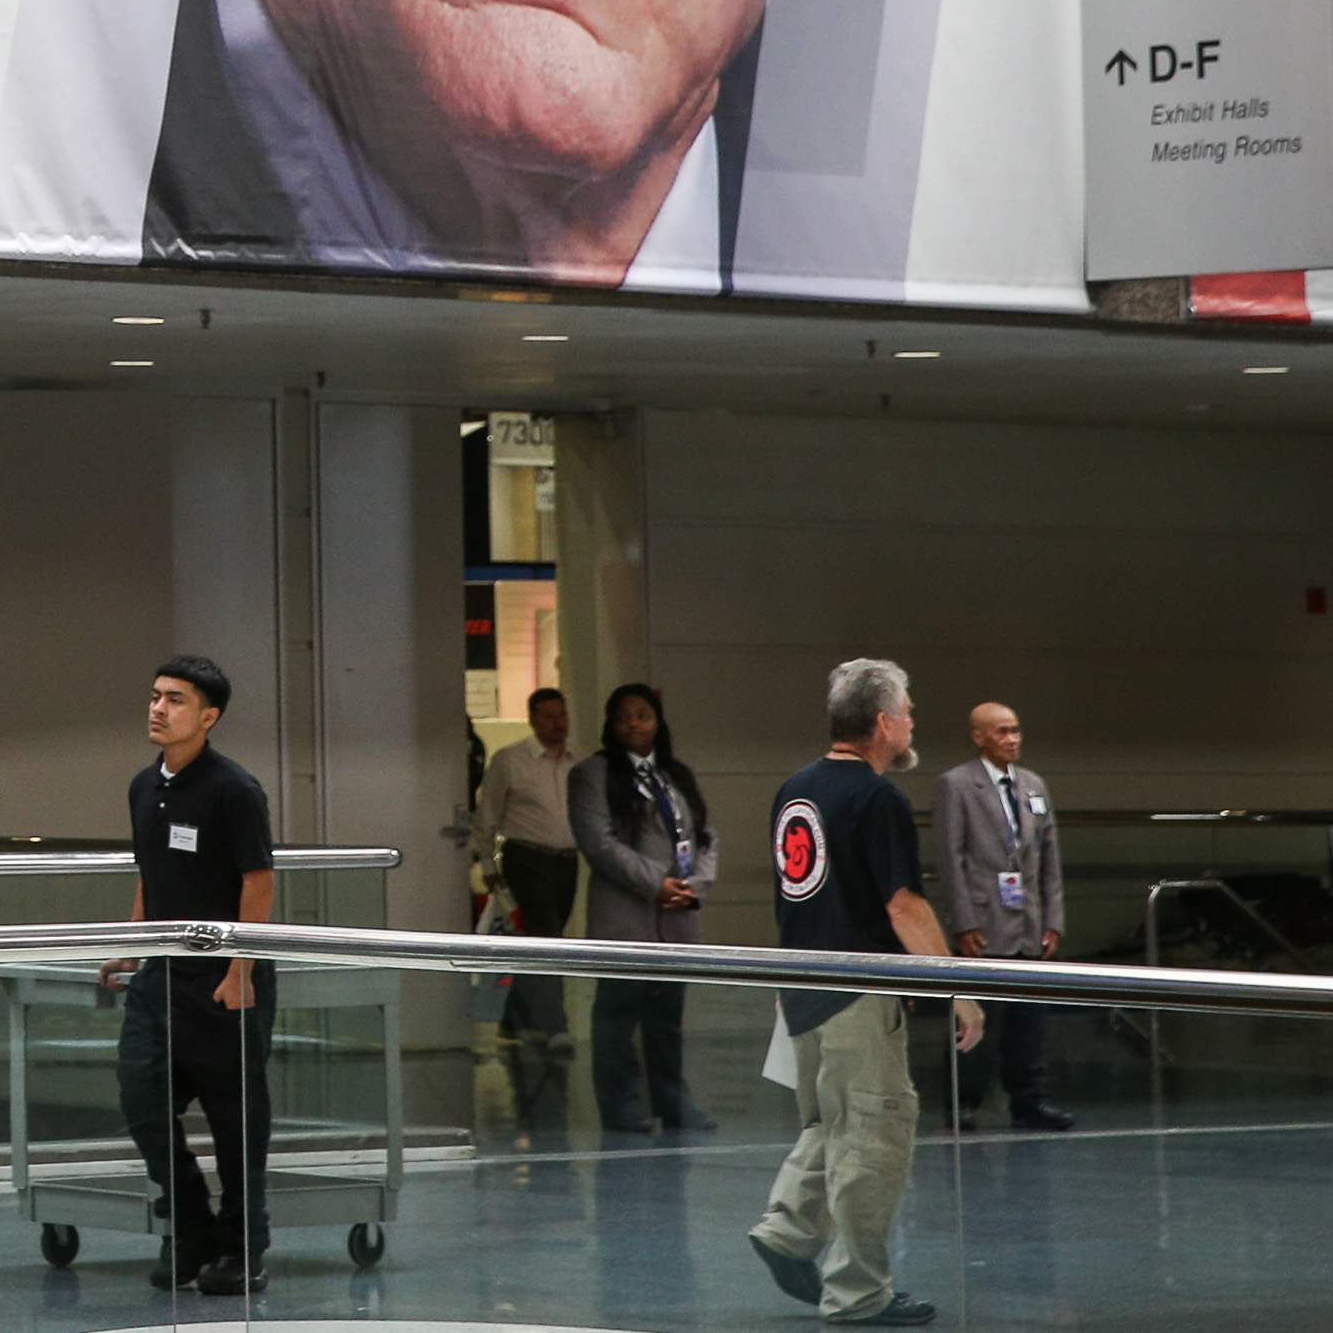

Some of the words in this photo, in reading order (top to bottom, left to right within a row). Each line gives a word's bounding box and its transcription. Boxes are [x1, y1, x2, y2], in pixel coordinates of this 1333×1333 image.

[1148, 39, 1221, 84] D-F
[1150, 102, 1216, 126] Exhibit
[1221, 97, 1271, 122] Halls
[1151, 138, 1228, 165] Meeting
[1233, 134, 1303, 158] Rooms
